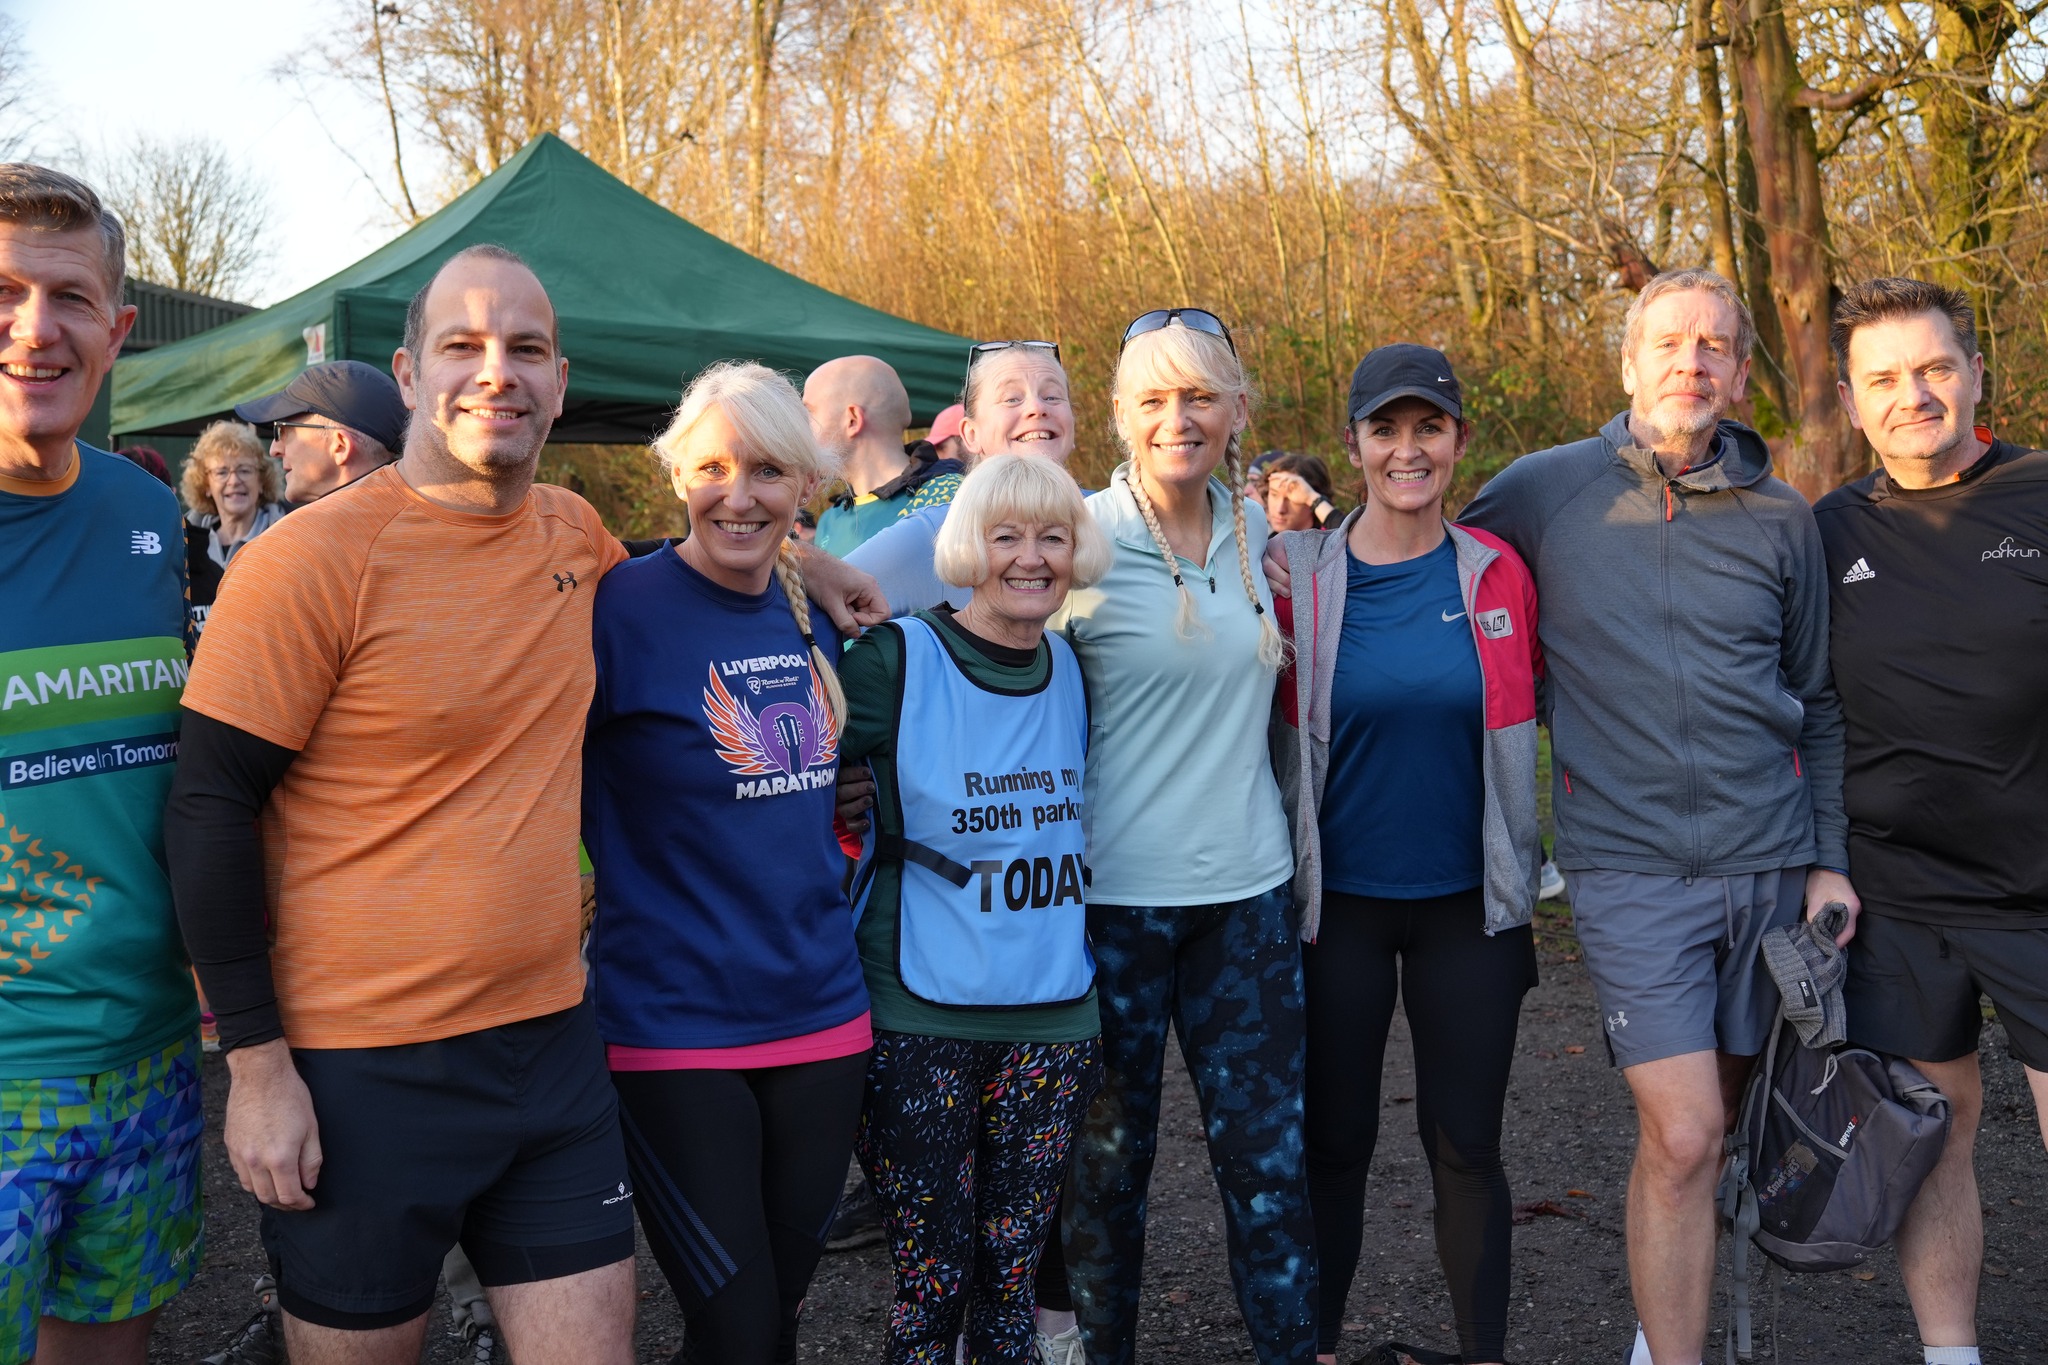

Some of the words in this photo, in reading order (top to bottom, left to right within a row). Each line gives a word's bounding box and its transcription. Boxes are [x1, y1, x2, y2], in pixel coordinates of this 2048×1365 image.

[1981, 537, 2040, 562] parkrun
[1843, 570, 1876, 584] adidas
[721, 654, 807, 676] LIVERPOOL
[0, 659, 188, 710] AMARITAN
[736, 768, 835, 799] MARATHON
[964, 767, 1056, 798] Running
[952, 803, 1022, 834] 350th
